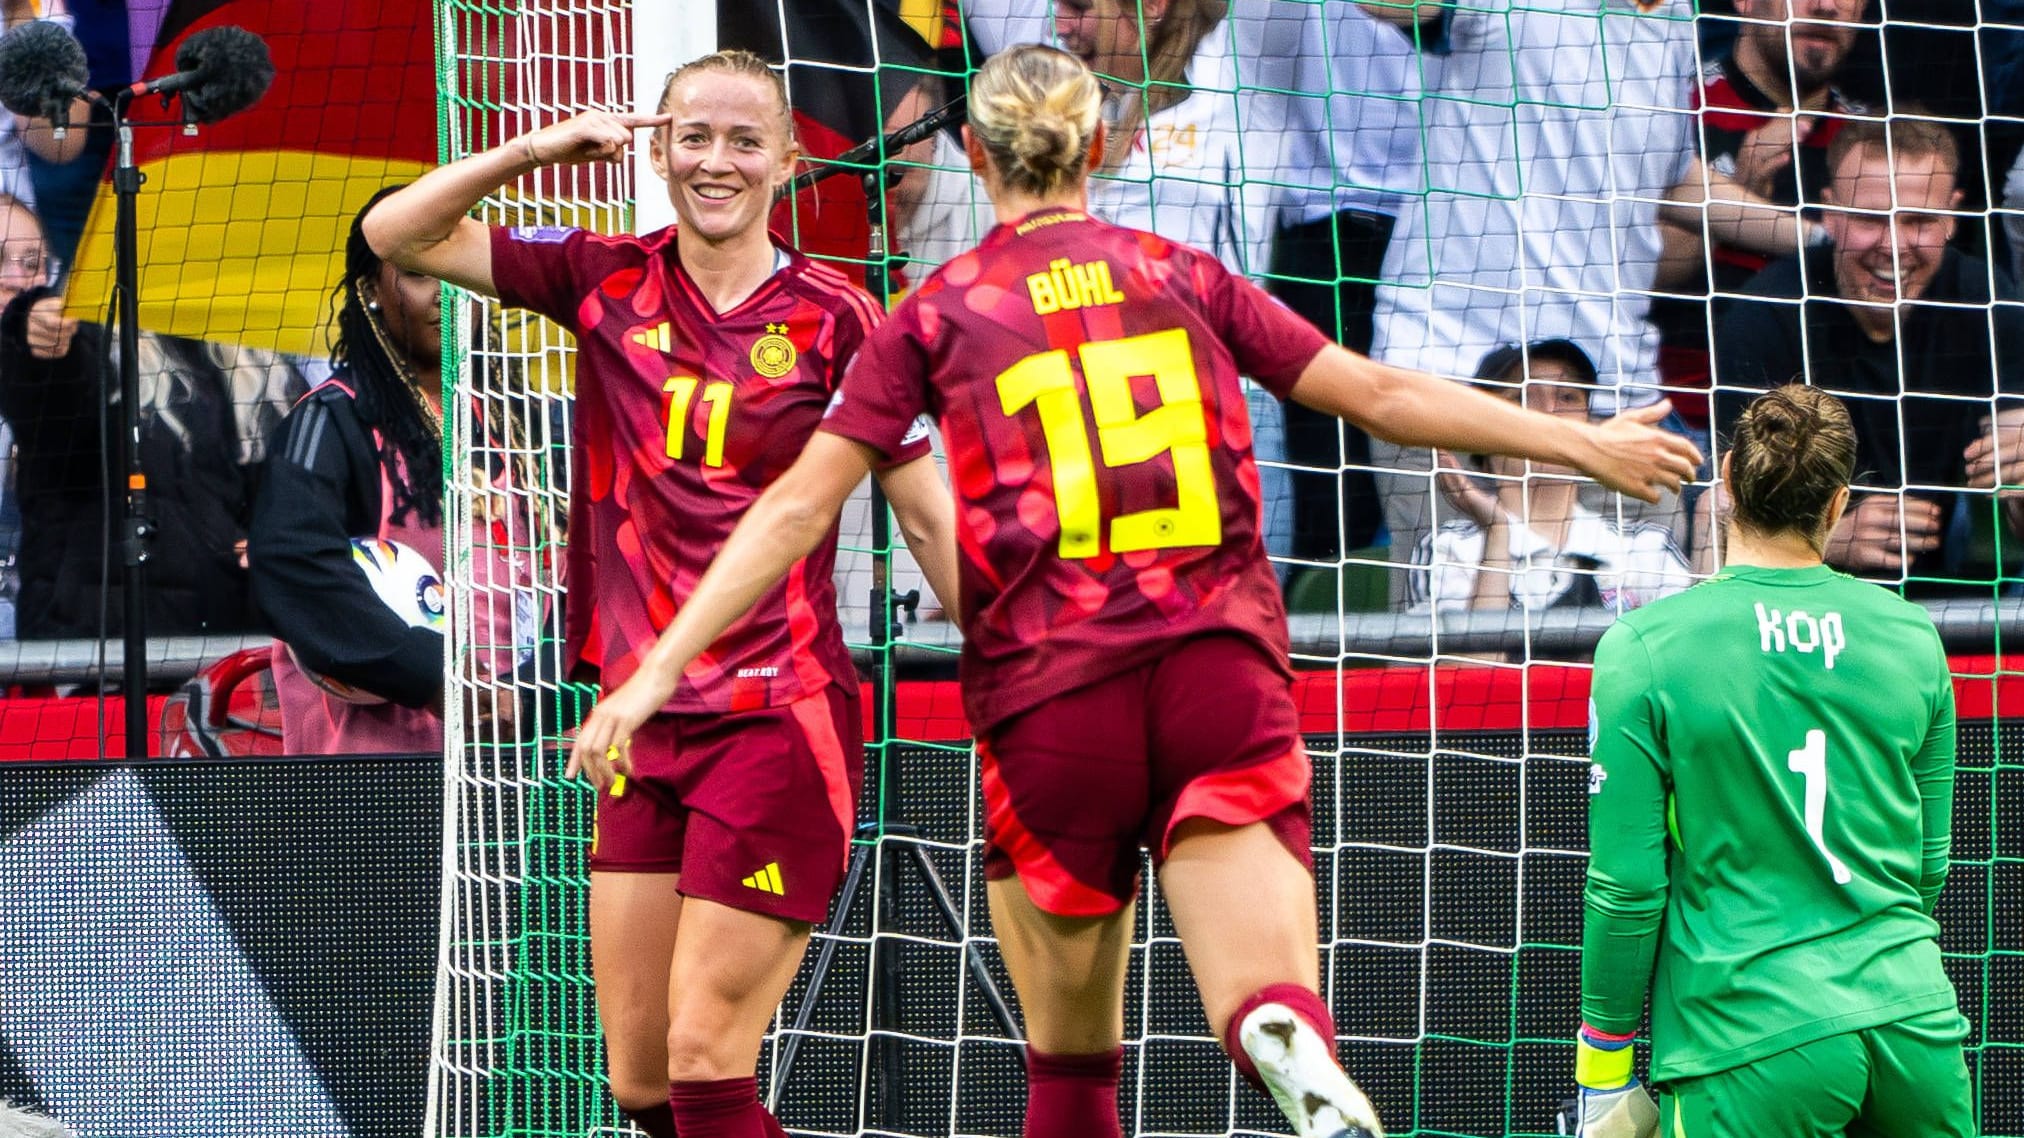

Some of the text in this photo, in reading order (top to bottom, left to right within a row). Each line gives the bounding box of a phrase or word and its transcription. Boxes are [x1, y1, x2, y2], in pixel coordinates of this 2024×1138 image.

[1026, 258, 1125, 315] BÜHL
[662, 376, 734, 467] 11
[995, 327, 1222, 559] 19
[1787, 729, 1852, 885] 1
